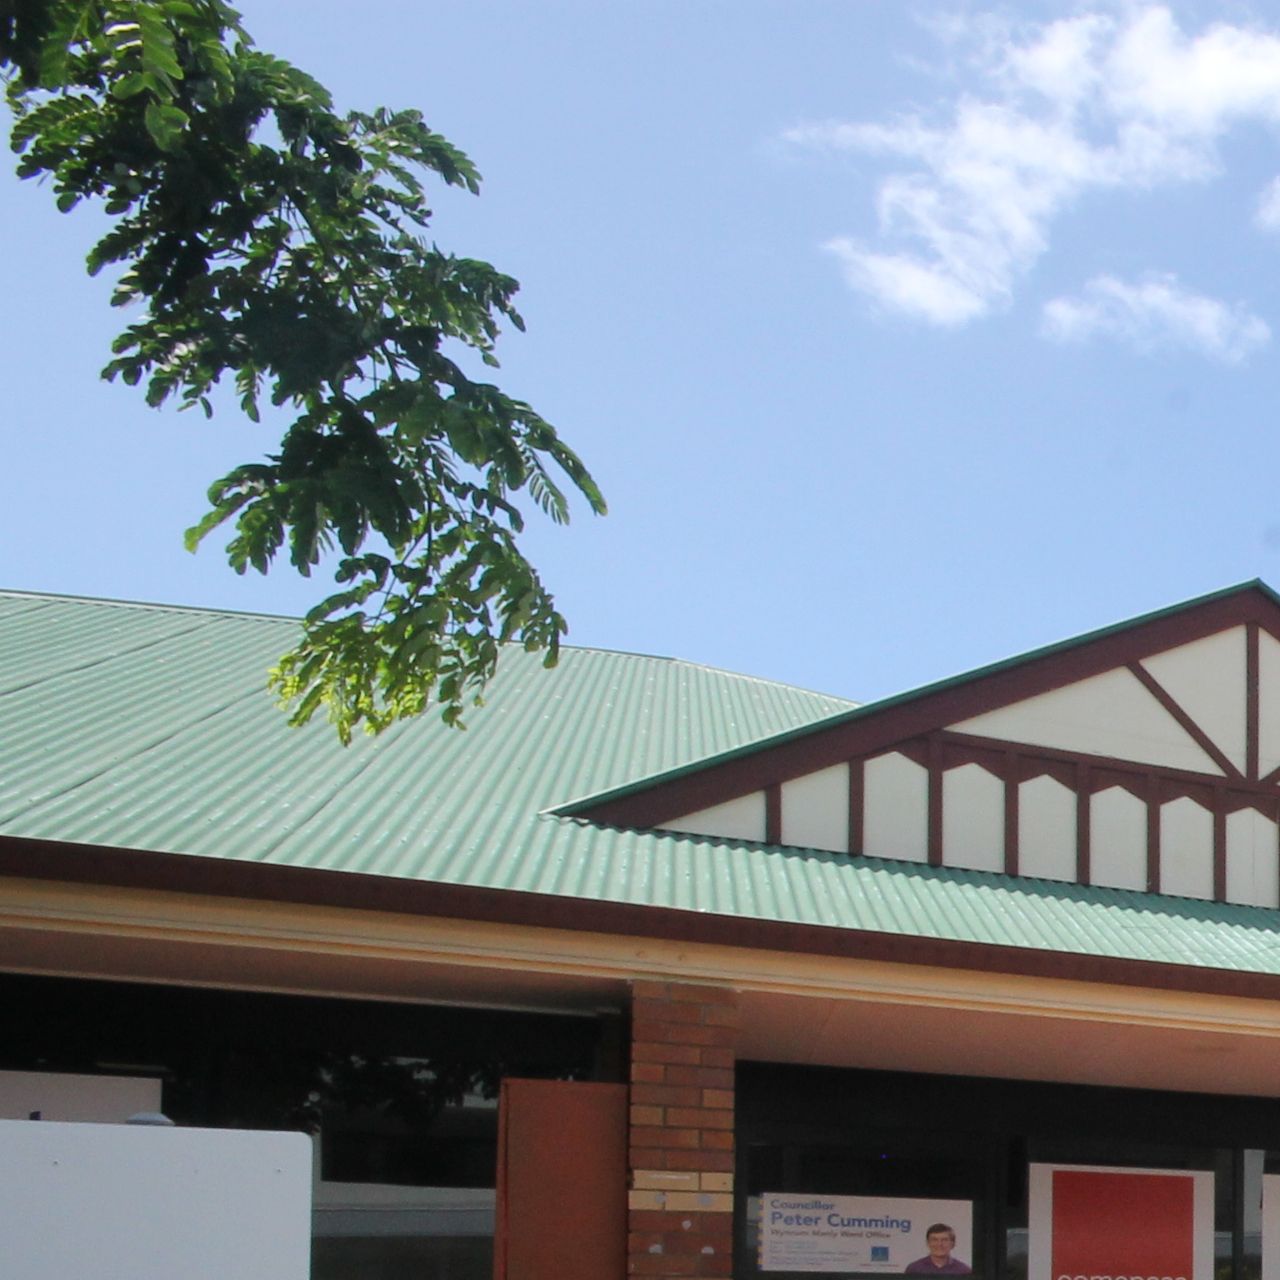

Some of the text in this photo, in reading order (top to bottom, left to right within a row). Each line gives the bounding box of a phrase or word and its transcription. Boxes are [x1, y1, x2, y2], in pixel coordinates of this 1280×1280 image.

[770, 1199, 836, 1211] Councillor
[770, 1211, 912, 1233] Peter Cumming
